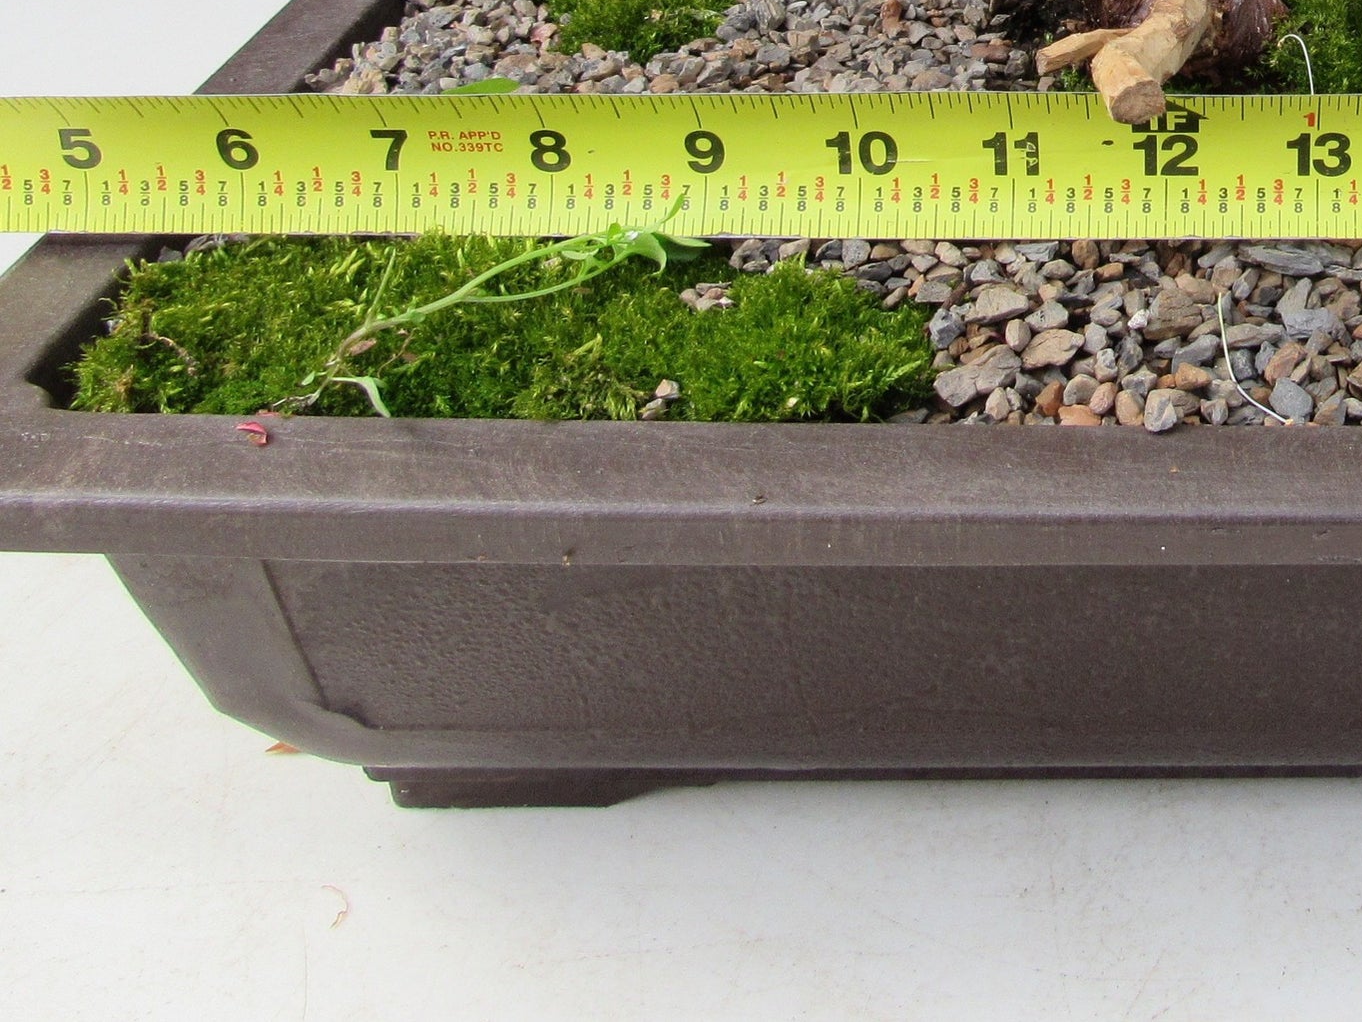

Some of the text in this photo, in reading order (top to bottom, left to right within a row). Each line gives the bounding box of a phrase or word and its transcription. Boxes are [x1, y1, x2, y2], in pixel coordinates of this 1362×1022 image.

[1303, 112, 1315, 127] 1
[427, 130, 501, 140] P.R. APP'D
[58, 129, 102, 169] 5
[216, 129, 259, 170] 6
[369, 129, 408, 171] 7
[529, 130, 571, 172] 8
[684, 130, 725, 173] 9
[825, 131, 898, 175] 10
[982, 131, 1040, 176] 11
[1133, 134, 1199, 176] 12
[1287, 133, 1351, 176] 13
